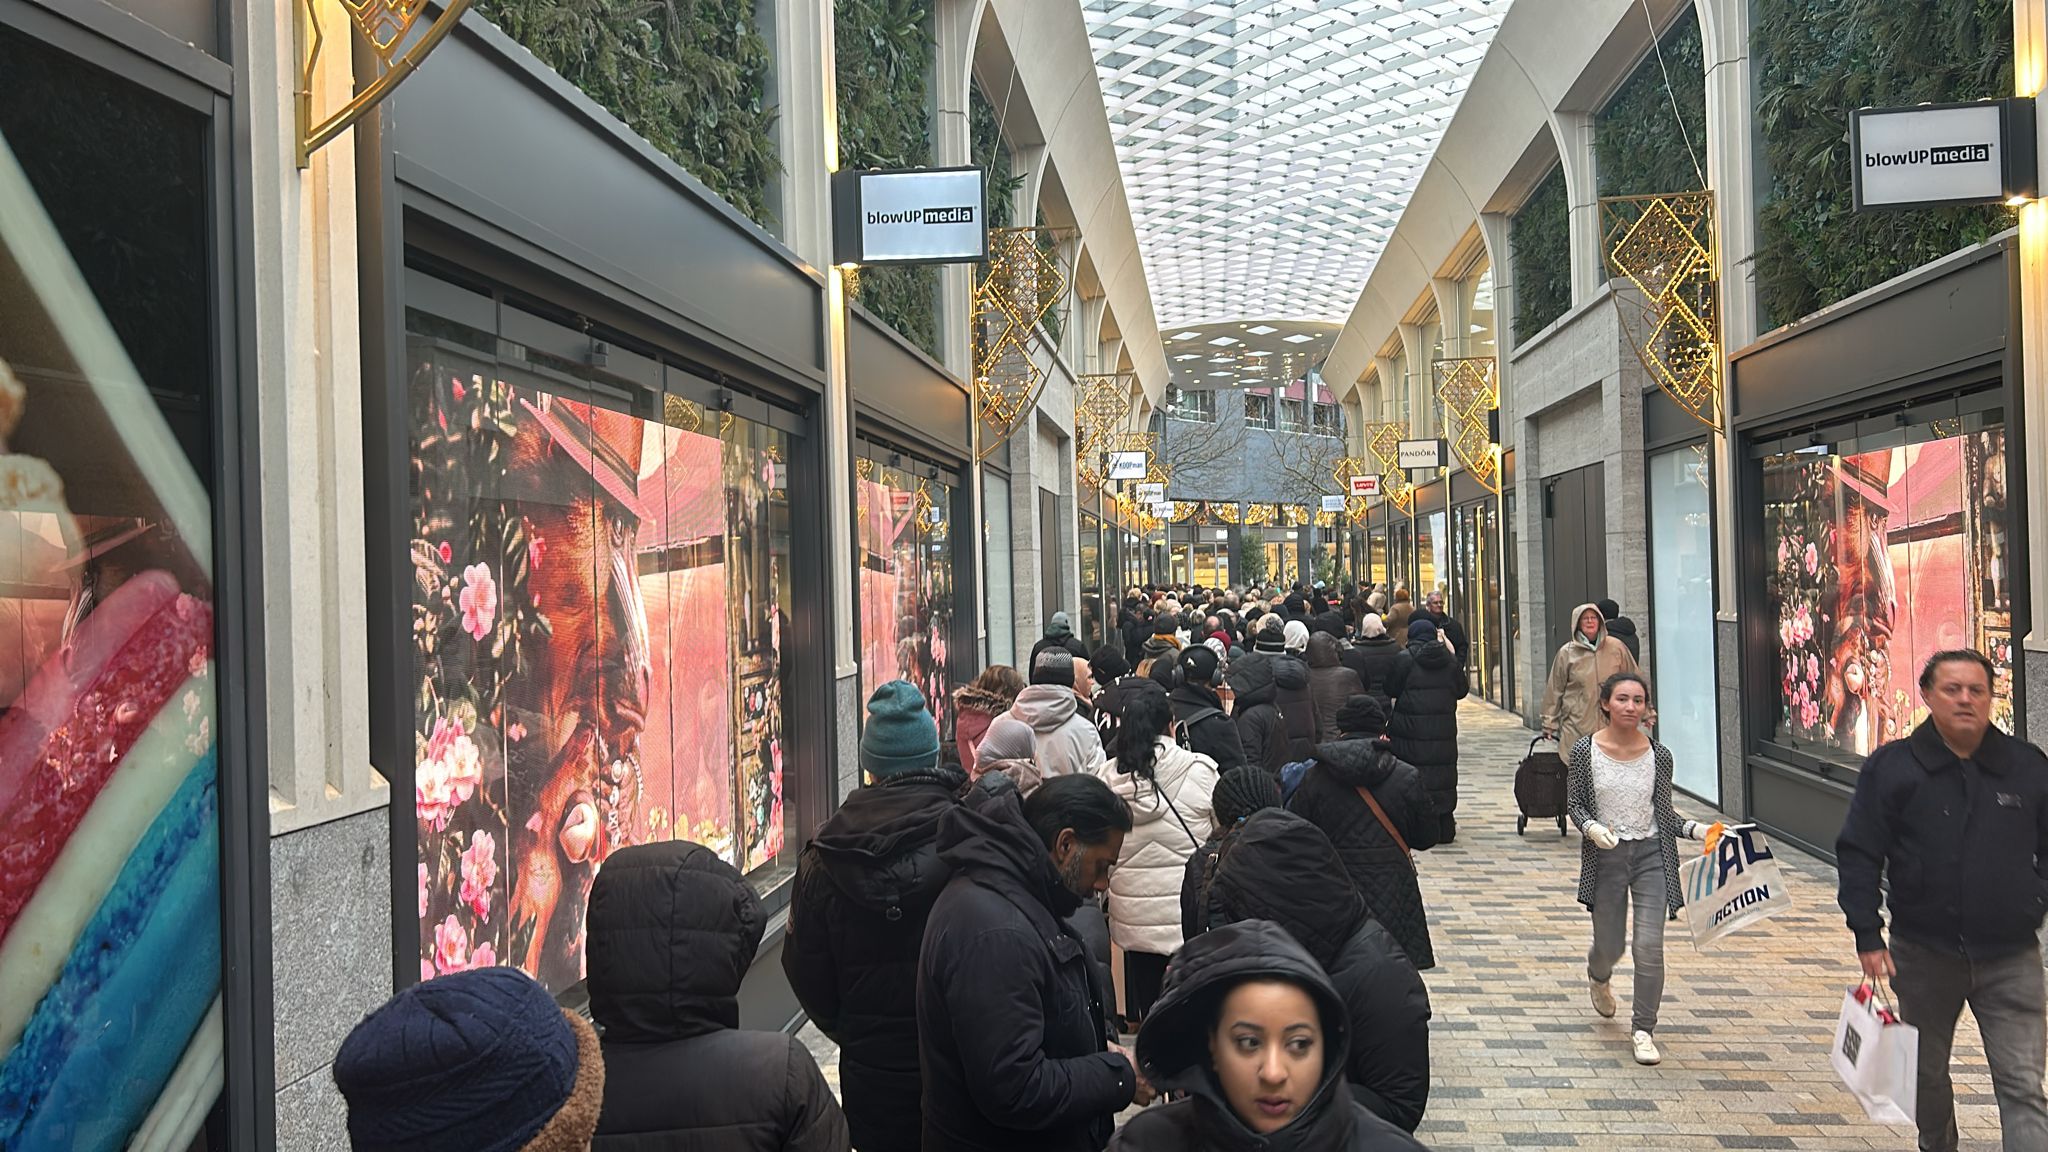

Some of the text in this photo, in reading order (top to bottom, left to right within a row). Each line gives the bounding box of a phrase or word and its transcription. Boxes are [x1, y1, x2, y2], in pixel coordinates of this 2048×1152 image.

[1866, 146, 1987, 167] blowUP media
[867, 207, 971, 224] blowUP media
[1400, 450, 1437, 458] PANDORA
[1714, 884, 1770, 925] ACTION
